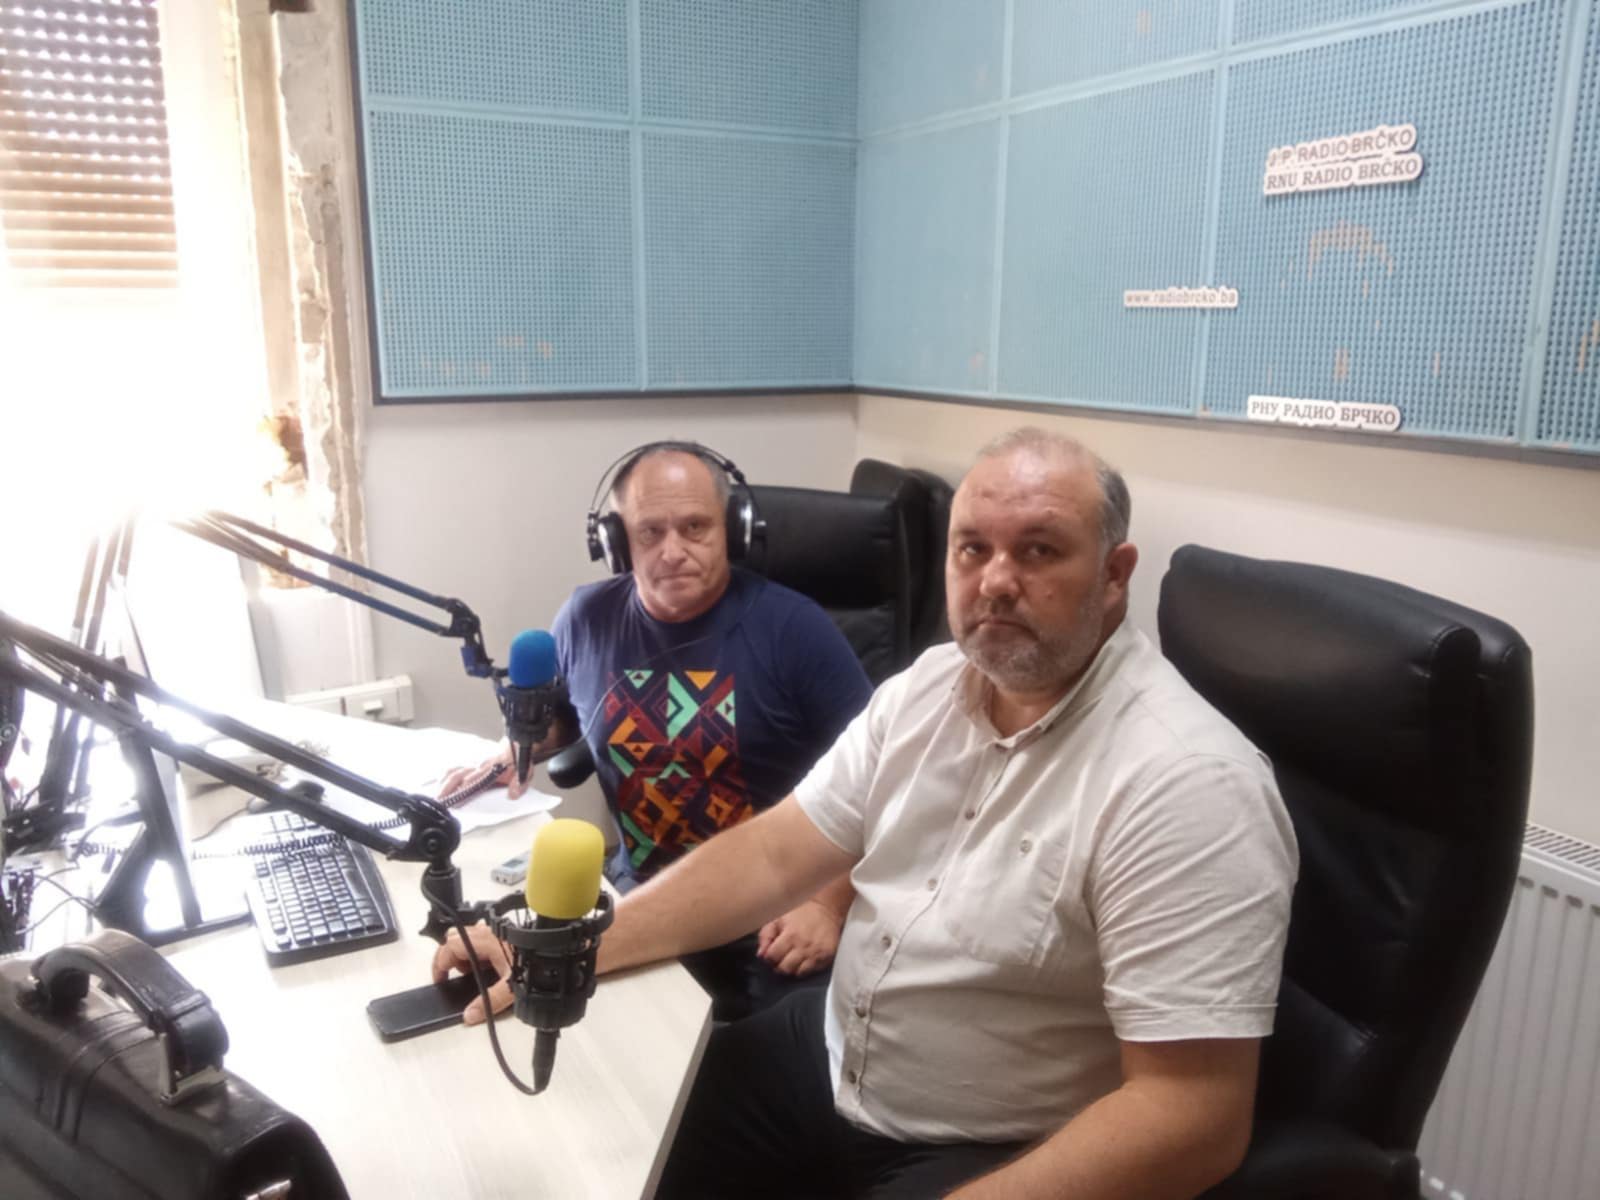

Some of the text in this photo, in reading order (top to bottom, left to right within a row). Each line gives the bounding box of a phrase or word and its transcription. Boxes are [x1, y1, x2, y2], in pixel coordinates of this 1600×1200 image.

[1298, 139, 1349, 161] RADIO
[1351, 128, 1412, 154] BRČKO
[1266, 157, 1418, 190] RNU RADIO BRČKO
[1251, 400, 1396, 425] РНУ РАДИО БРЧКО
